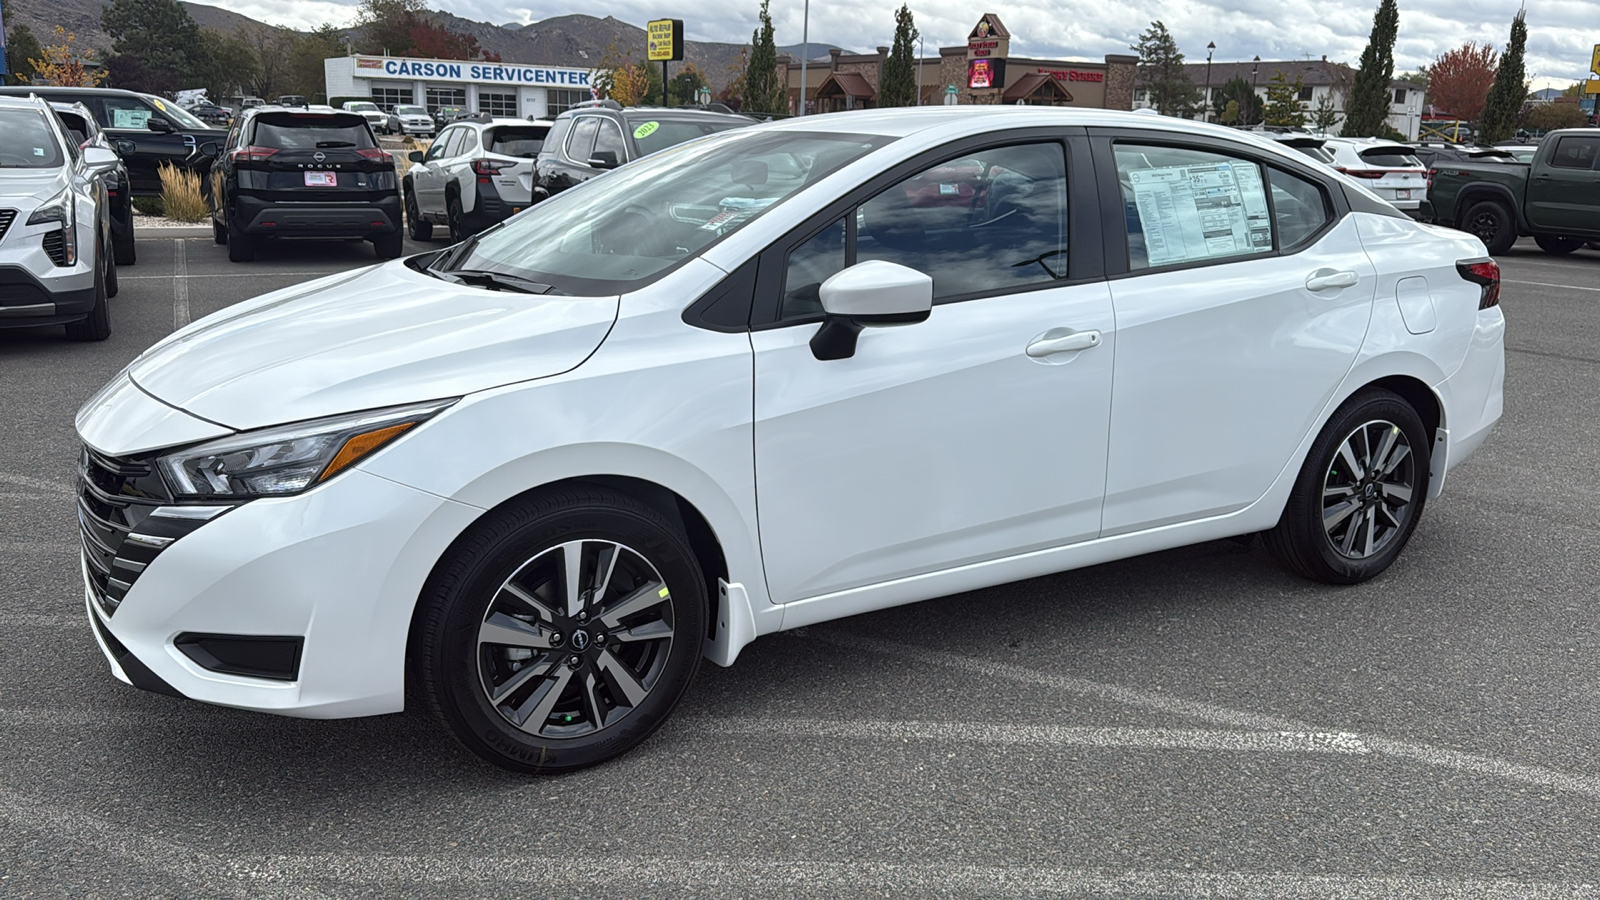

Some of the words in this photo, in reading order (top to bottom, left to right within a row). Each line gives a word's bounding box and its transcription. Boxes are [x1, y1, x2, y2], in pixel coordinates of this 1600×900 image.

[385, 61, 461, 78] CARSON
[470, 65, 590, 85] SERVICENTER
[1069, 69, 1103, 82] STRIKE
[638, 122, 656, 137] 2023
